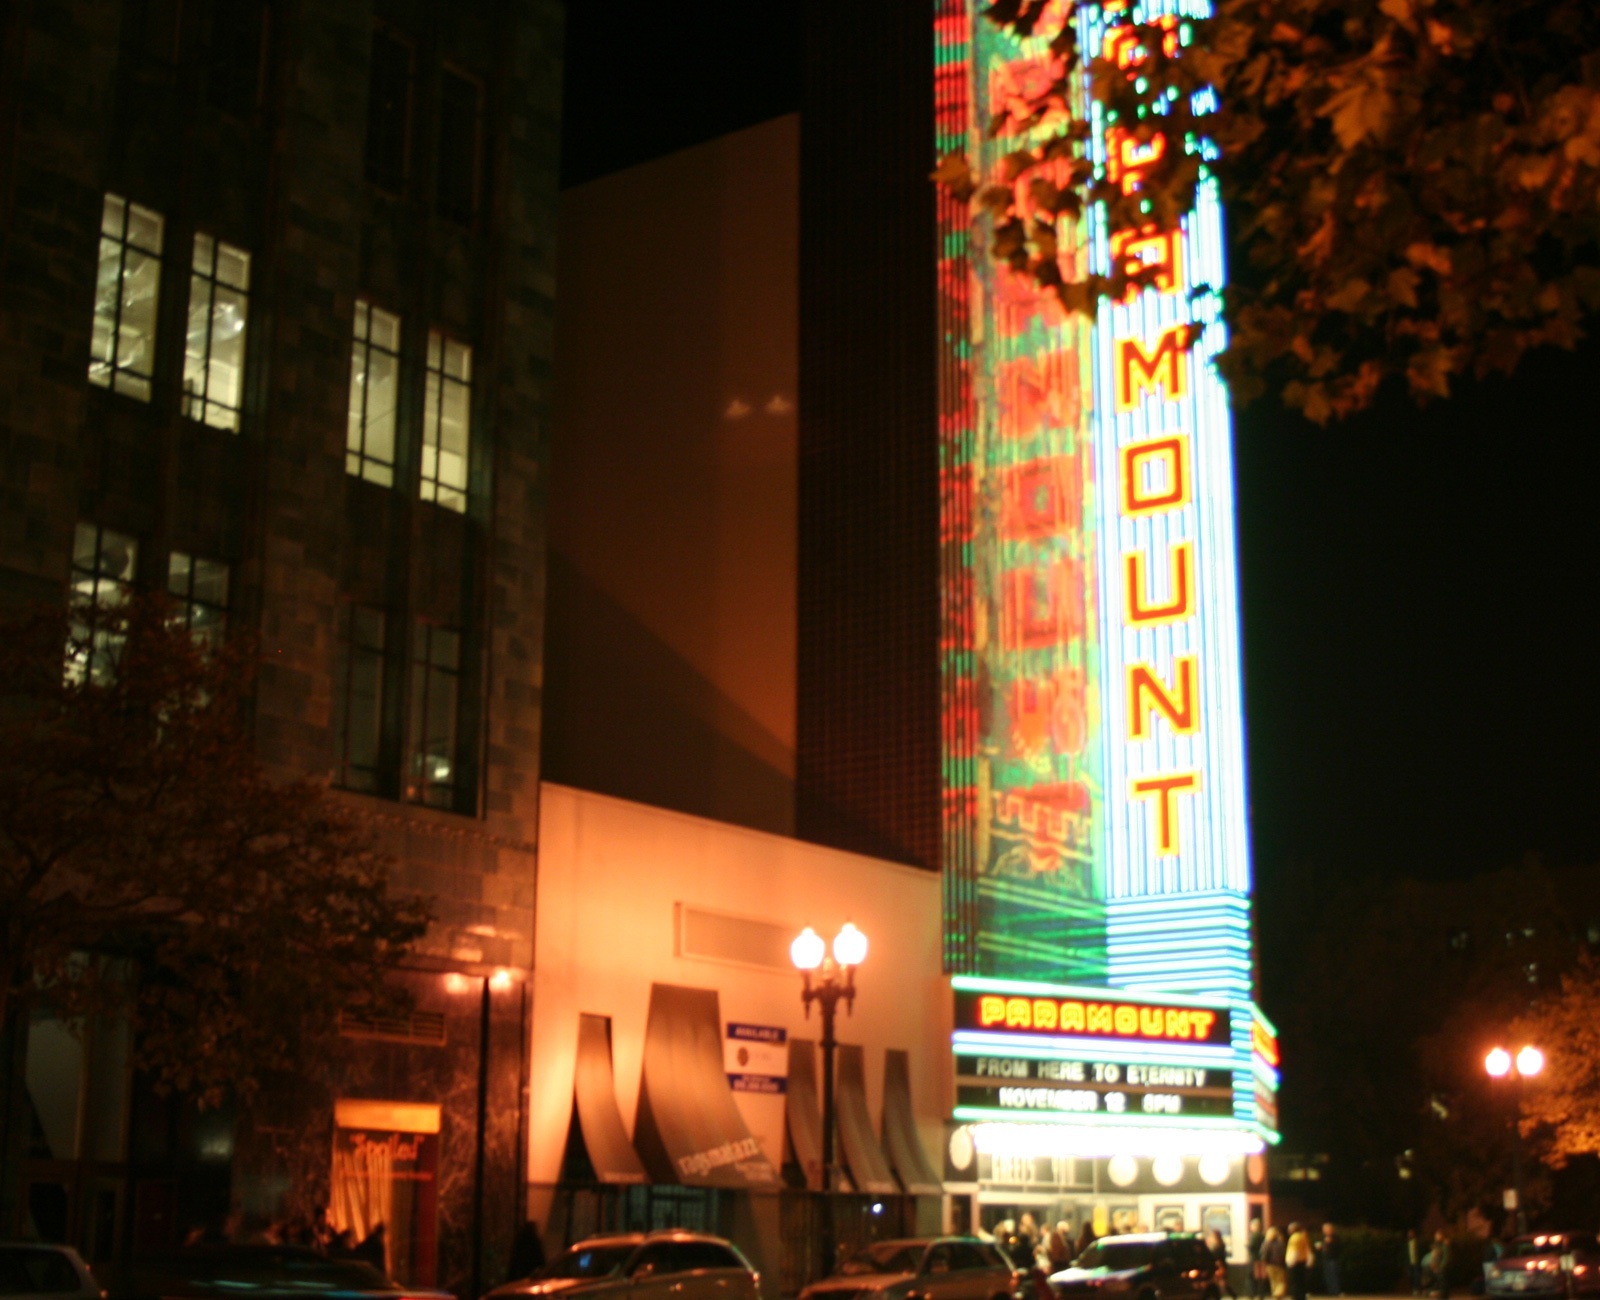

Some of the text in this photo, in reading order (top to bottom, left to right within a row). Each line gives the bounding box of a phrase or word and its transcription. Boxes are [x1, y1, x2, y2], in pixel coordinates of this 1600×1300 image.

[1103, 0, 1202, 858] RAMOUNT
[979, 996, 1214, 1039] PARAMOUNT
[976, 1058, 1206, 1087] FROM HERE TO ETERNITY
[1000, 1087, 1098, 1111] NOVEMBER
